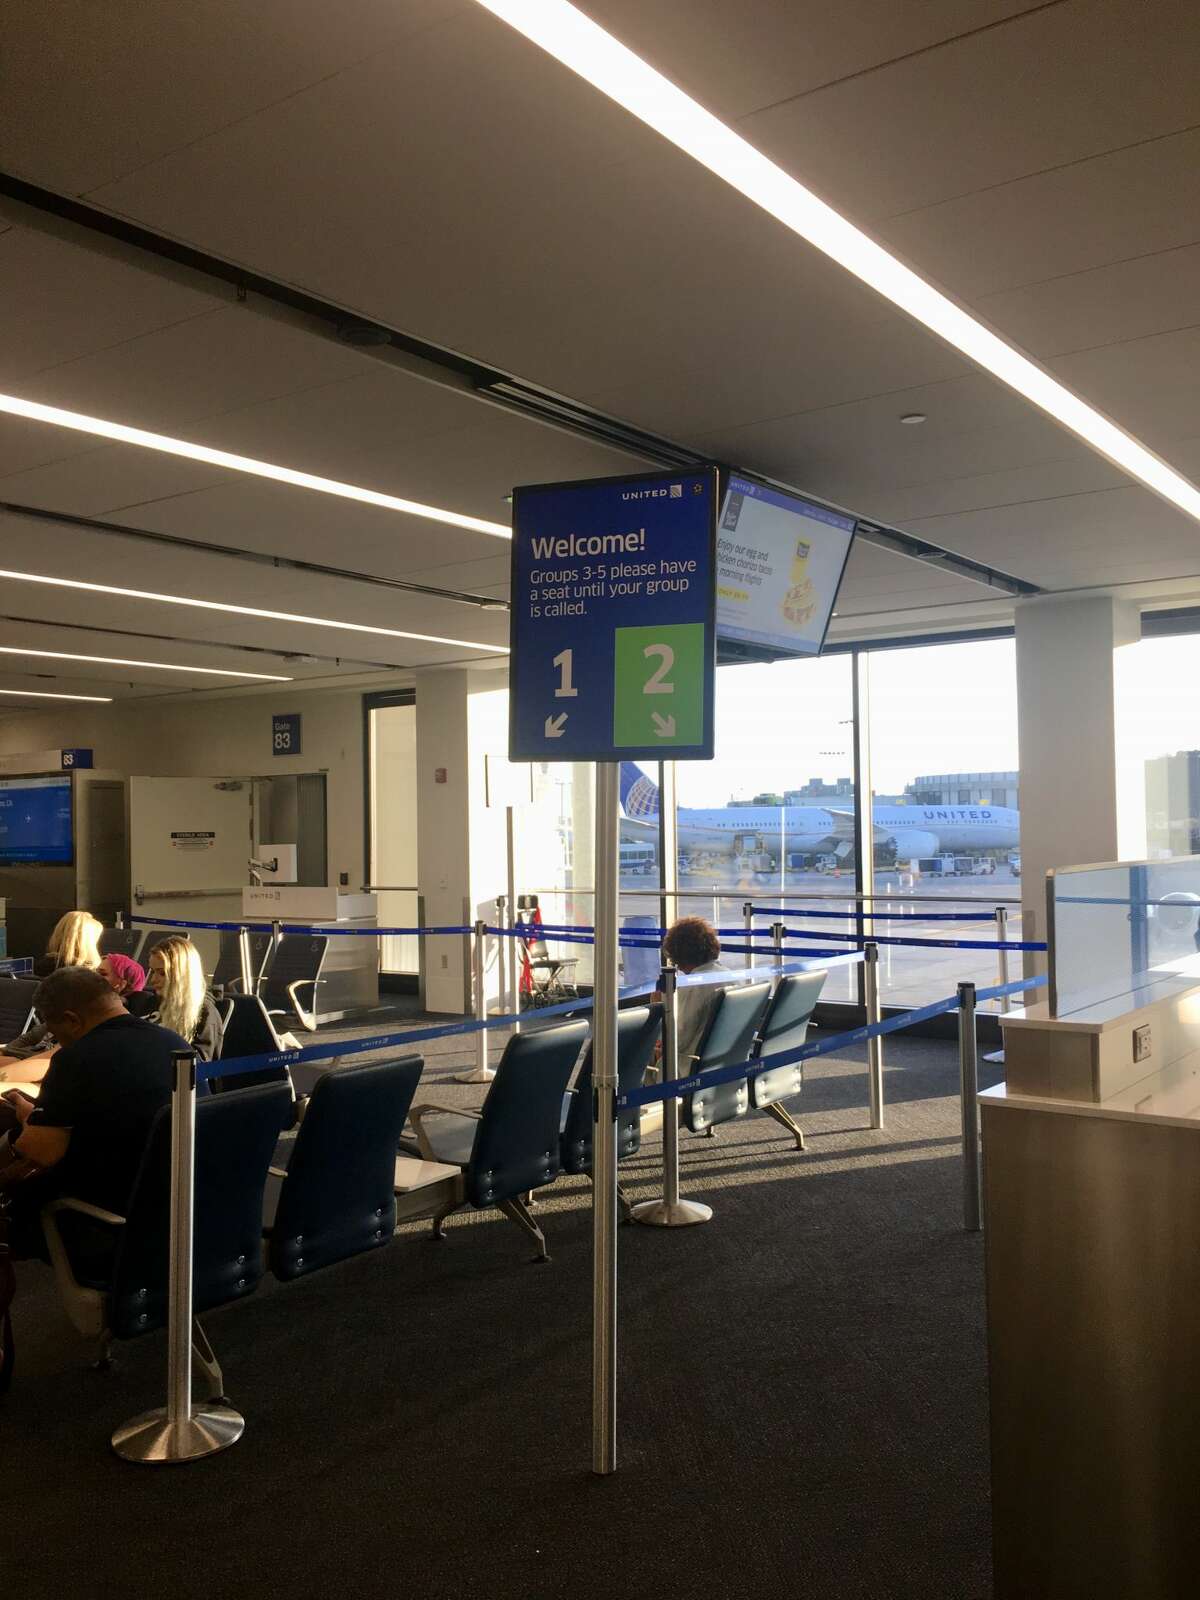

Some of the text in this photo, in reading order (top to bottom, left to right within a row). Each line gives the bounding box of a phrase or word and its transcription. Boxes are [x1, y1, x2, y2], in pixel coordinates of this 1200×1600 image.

[622, 488, 668, 500] UNITED
[531, 528, 646, 560] Welcome!
[530, 559, 697, 584] Groups 3-5 please have
[530, 578, 689, 601] a seat until your group
[530, 601, 588, 618] is called.
[553, 649, 578, 697] 1
[643, 643, 675, 694] 2
[274, 721, 290, 730] Gate
[274, 733, 290, 749] 83
[63, 754, 74, 766] 83
[923, 810, 992, 819] UNITED
[268, 1054, 292, 1062] UNITED
